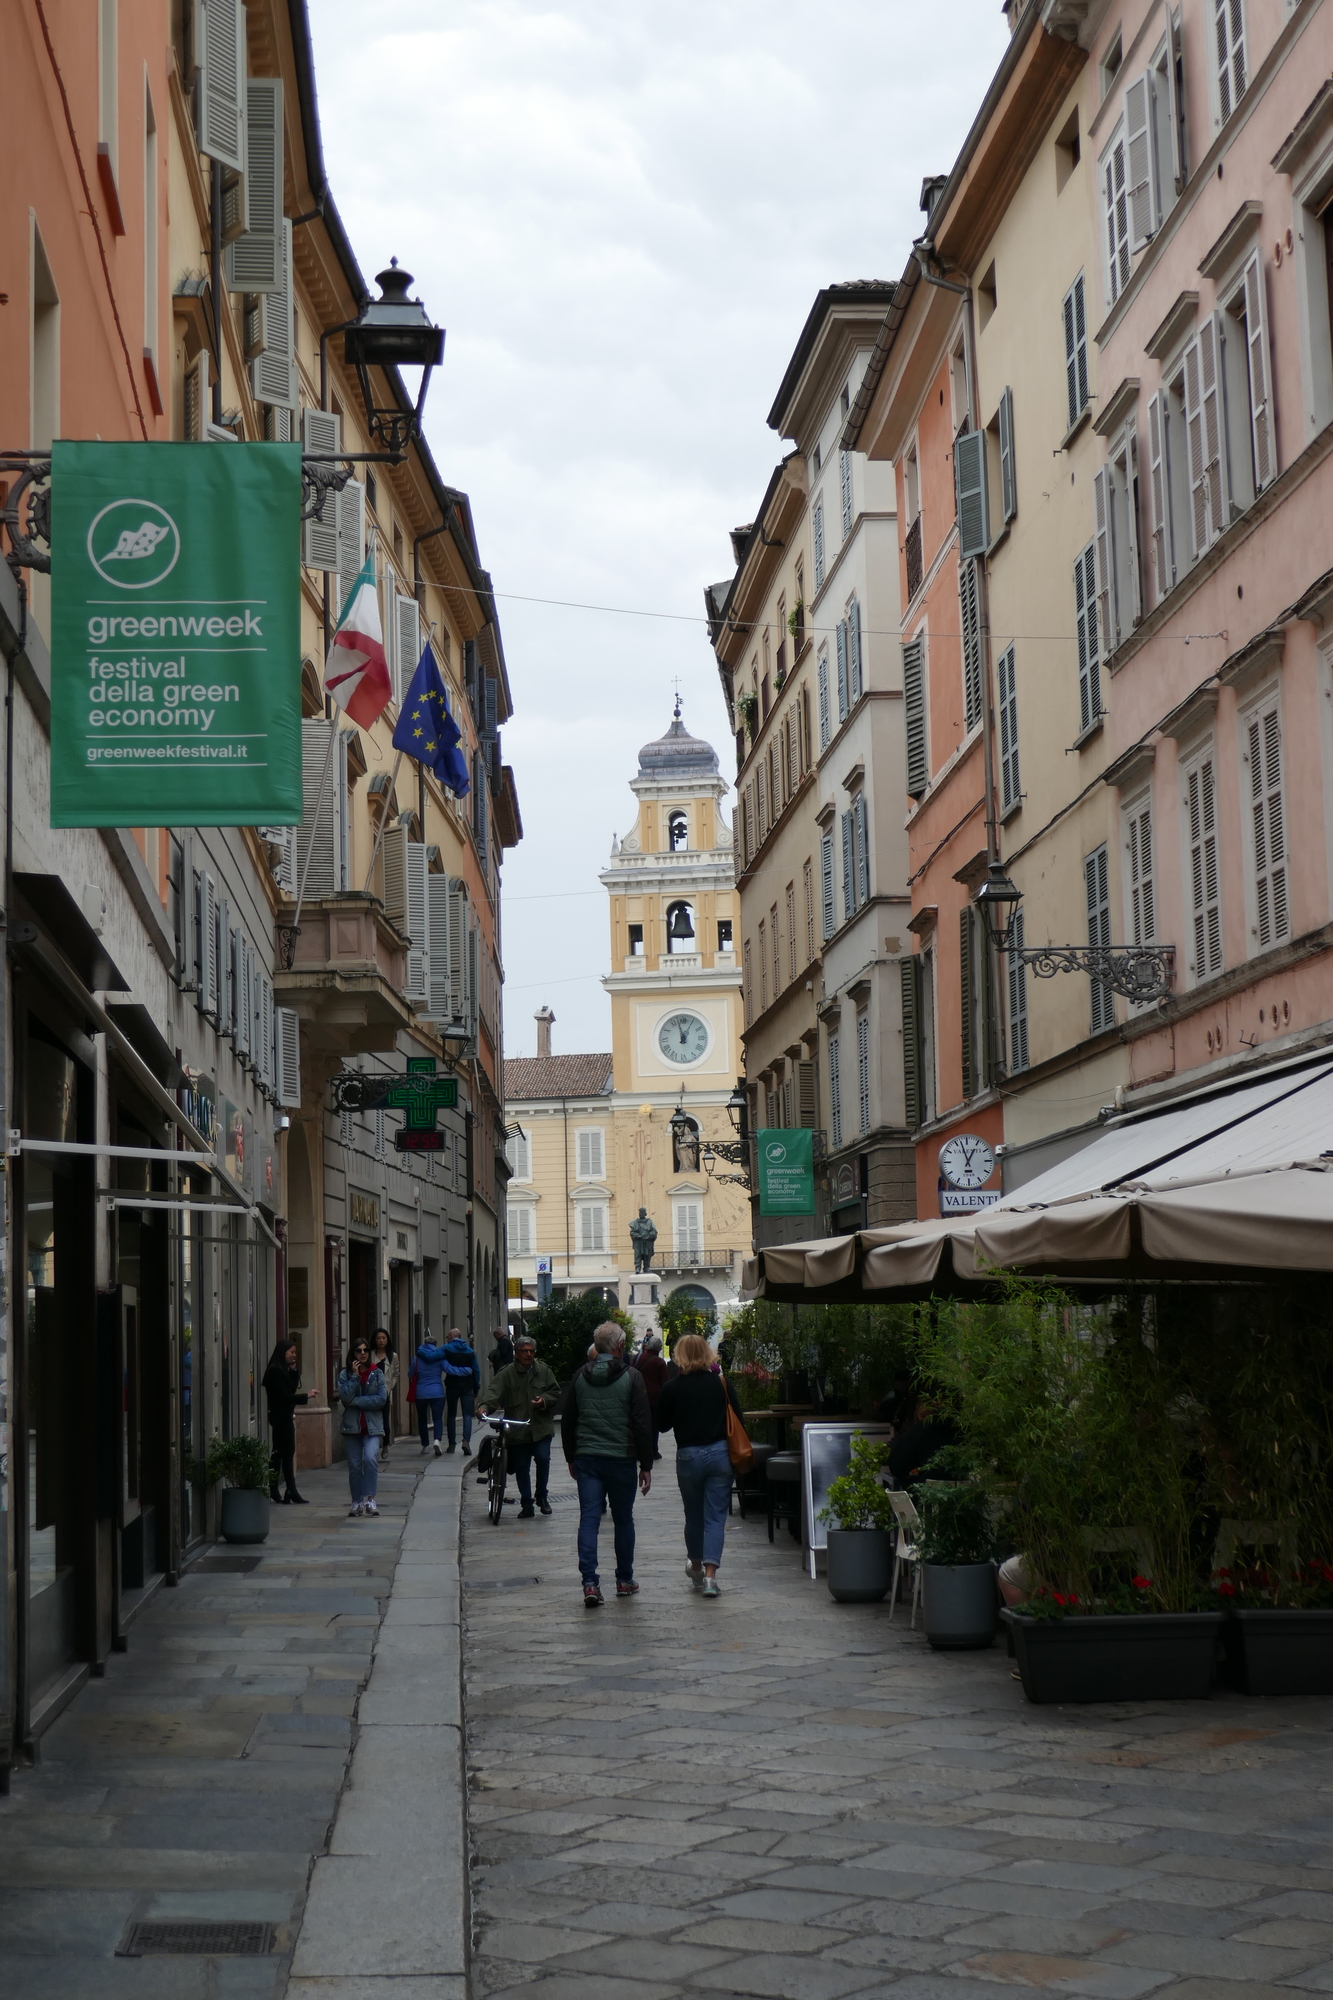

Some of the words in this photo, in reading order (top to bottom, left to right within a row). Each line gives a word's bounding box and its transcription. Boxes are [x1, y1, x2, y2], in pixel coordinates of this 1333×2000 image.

[88, 610, 263, 644] greenweek
[89, 656, 186, 679] festival
[89, 680, 155, 703] della
[163, 684, 240, 707] green
[89, 706, 216, 731] economy
[87, 744, 248, 760] greenweekfestival.it
[766, 1167, 805, 1175] greenweek
